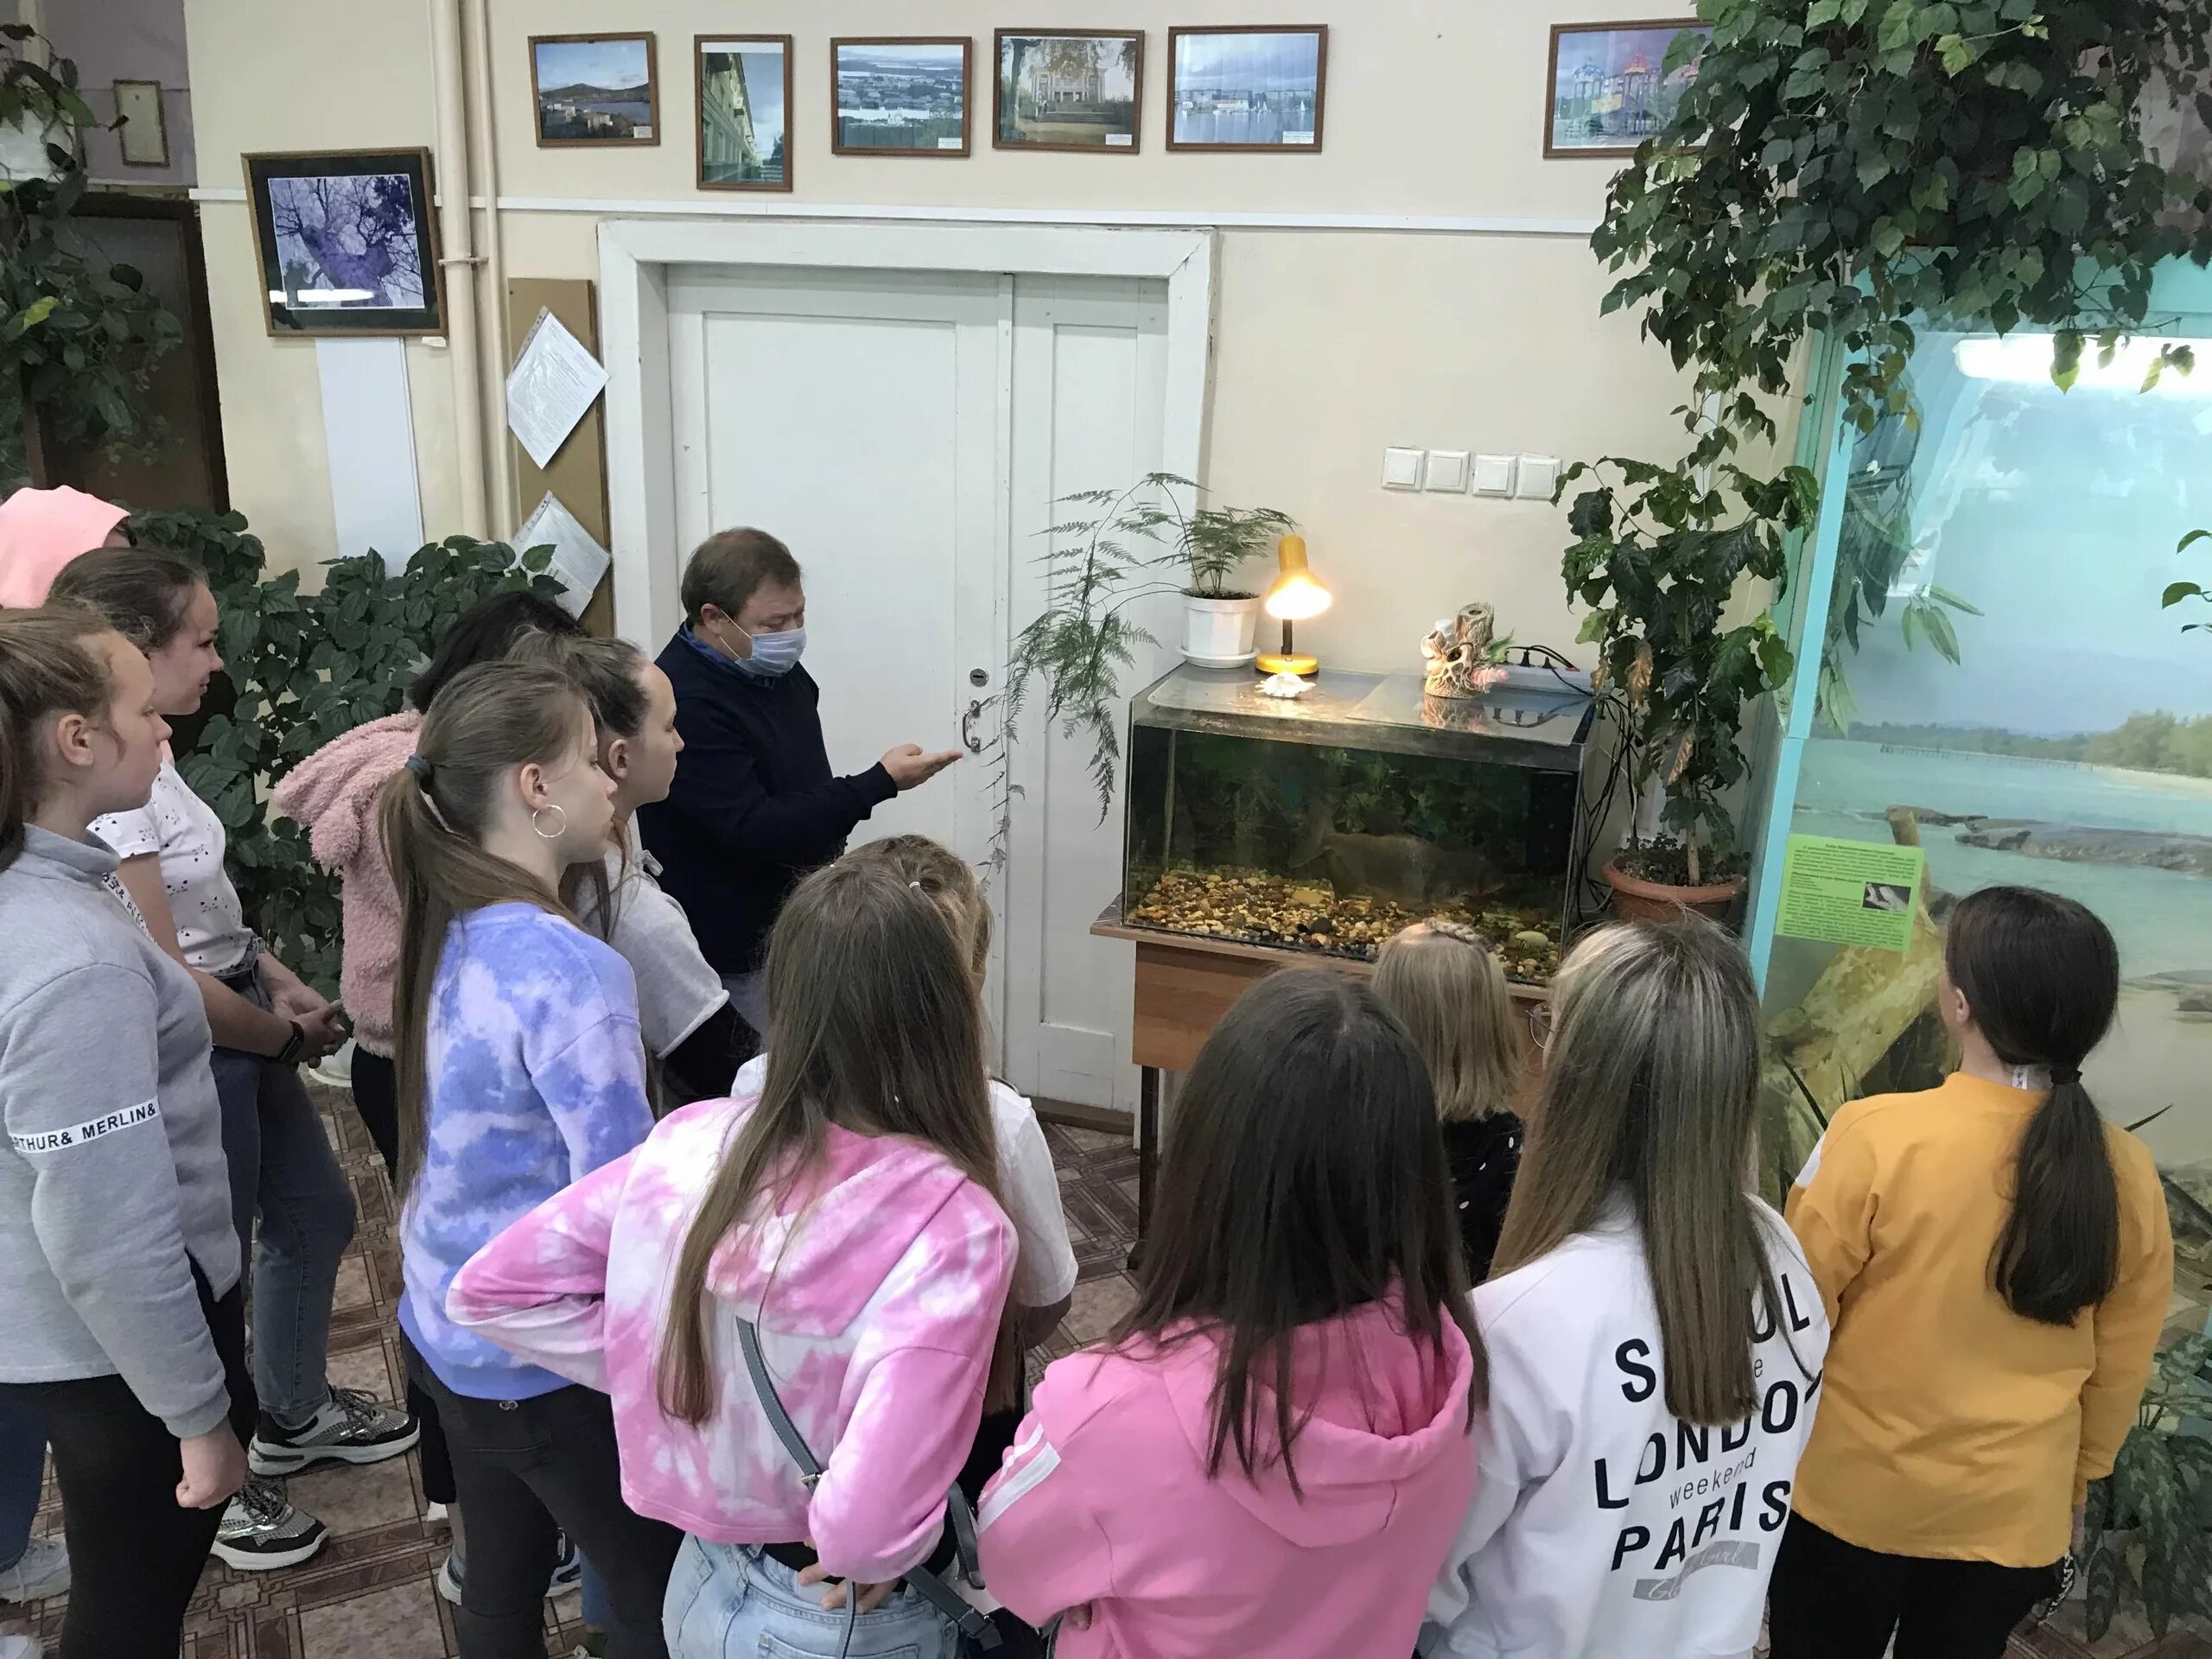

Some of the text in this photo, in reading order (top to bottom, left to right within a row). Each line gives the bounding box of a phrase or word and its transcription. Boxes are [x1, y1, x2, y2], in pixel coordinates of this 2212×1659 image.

[81, 1103, 156, 1140] MERLIN&
[1594, 1370, 1823, 1510] LONDO
[1669, 1446, 1757, 1510] weekend
[1610, 1480, 1792, 1572] PARIS
